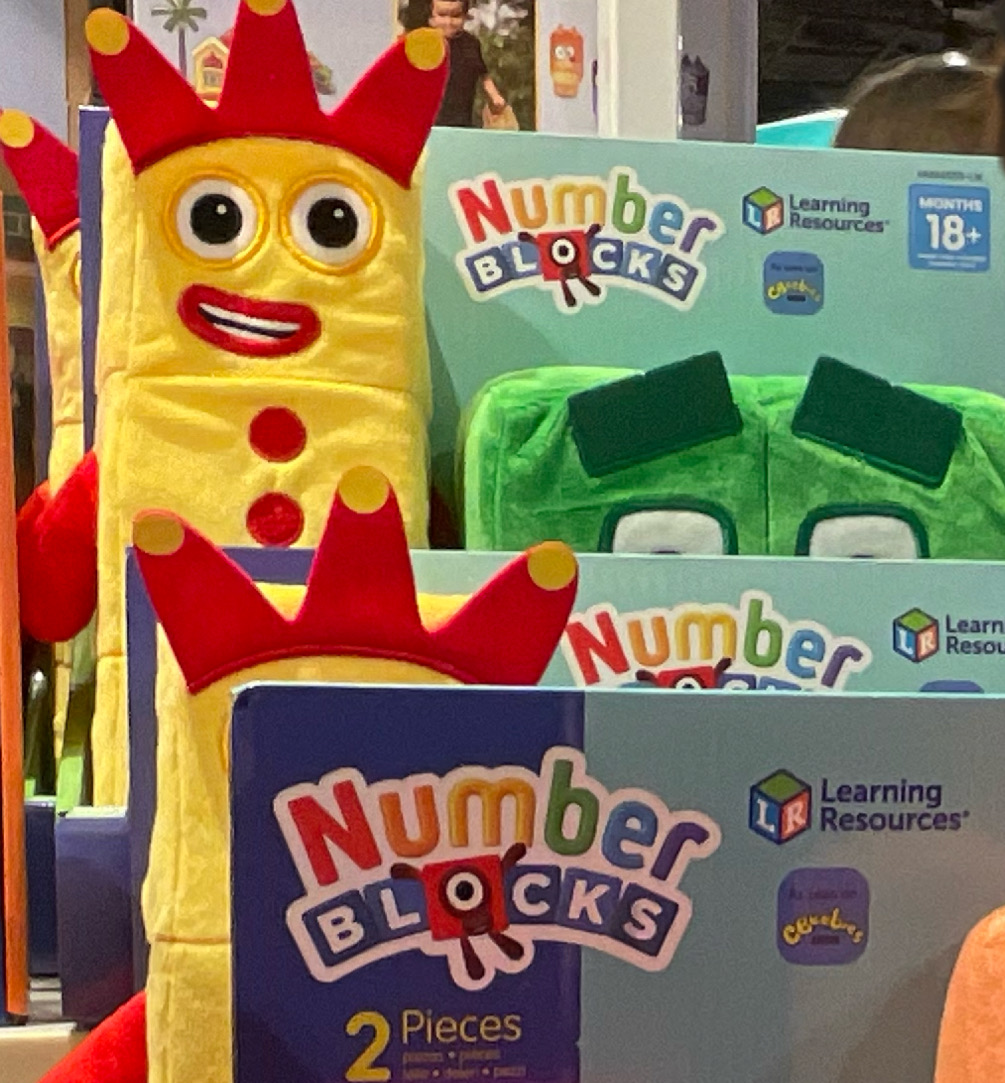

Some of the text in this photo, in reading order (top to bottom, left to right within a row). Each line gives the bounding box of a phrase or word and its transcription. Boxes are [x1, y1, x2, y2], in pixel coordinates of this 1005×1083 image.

[456, 173, 717, 252] Number
[788, 194, 870, 217] Learning
[789, 212, 889, 233] Resources
[919, 197, 983, 212] MONTHS
[926, 213, 982, 251] 18+
[468, 238, 692, 295] BLOCKS
[567, 598, 863, 687] Number
[821, 778, 942, 808] Learning
[288, 759, 709, 886] Number
[821, 807, 969, 832] Resources
[310, 862, 672, 960] BLOCKS
[346, 1008, 523, 1083] 2 Pieces
